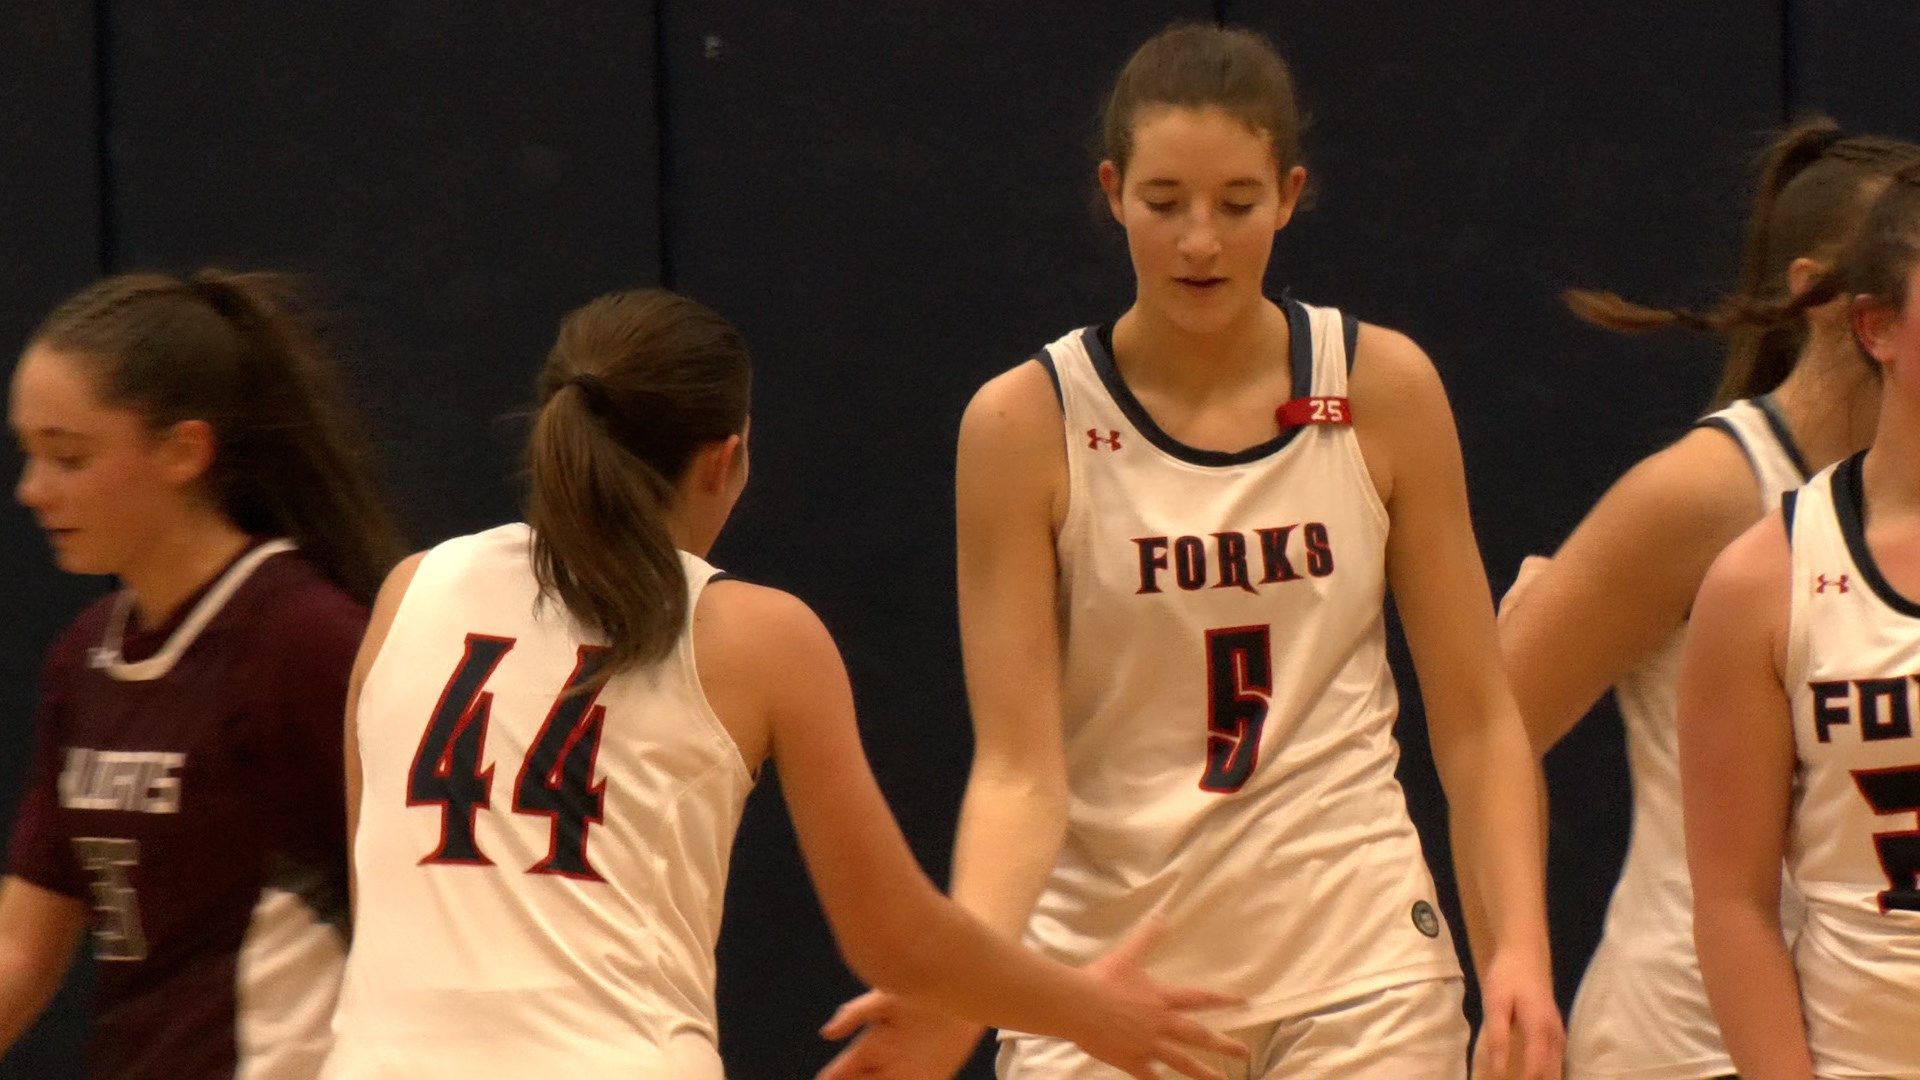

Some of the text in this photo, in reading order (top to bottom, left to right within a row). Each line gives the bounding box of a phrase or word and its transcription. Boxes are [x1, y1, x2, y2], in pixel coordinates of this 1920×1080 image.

[1309, 399, 1343, 422] 25
[1130, 521, 1335, 596] FORKS
[1199, 623, 1273, 794] 5
[1807, 673, 1920, 744] FO
[405, 632, 609, 884] 44
